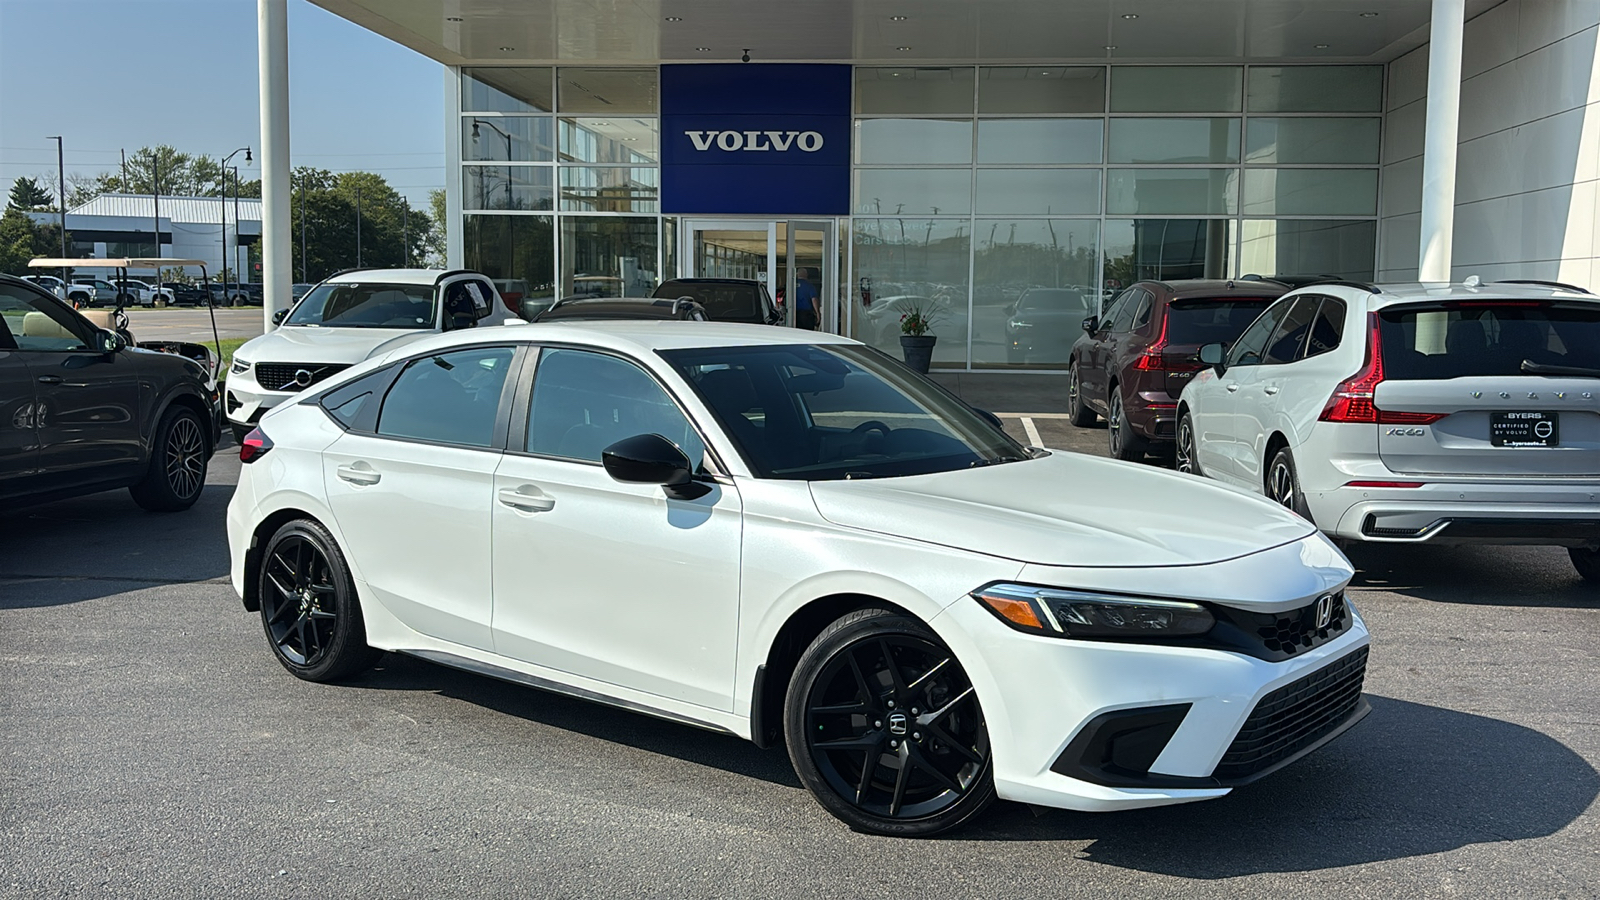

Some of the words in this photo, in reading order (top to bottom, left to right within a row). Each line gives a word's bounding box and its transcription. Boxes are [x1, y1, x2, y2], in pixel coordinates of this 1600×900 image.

[684, 130, 824, 152] VOLVO
[855, 234, 882, 245] Cars
[1469, 391, 1592, 400] VOLVO
[1385, 427, 1425, 437] XC60
